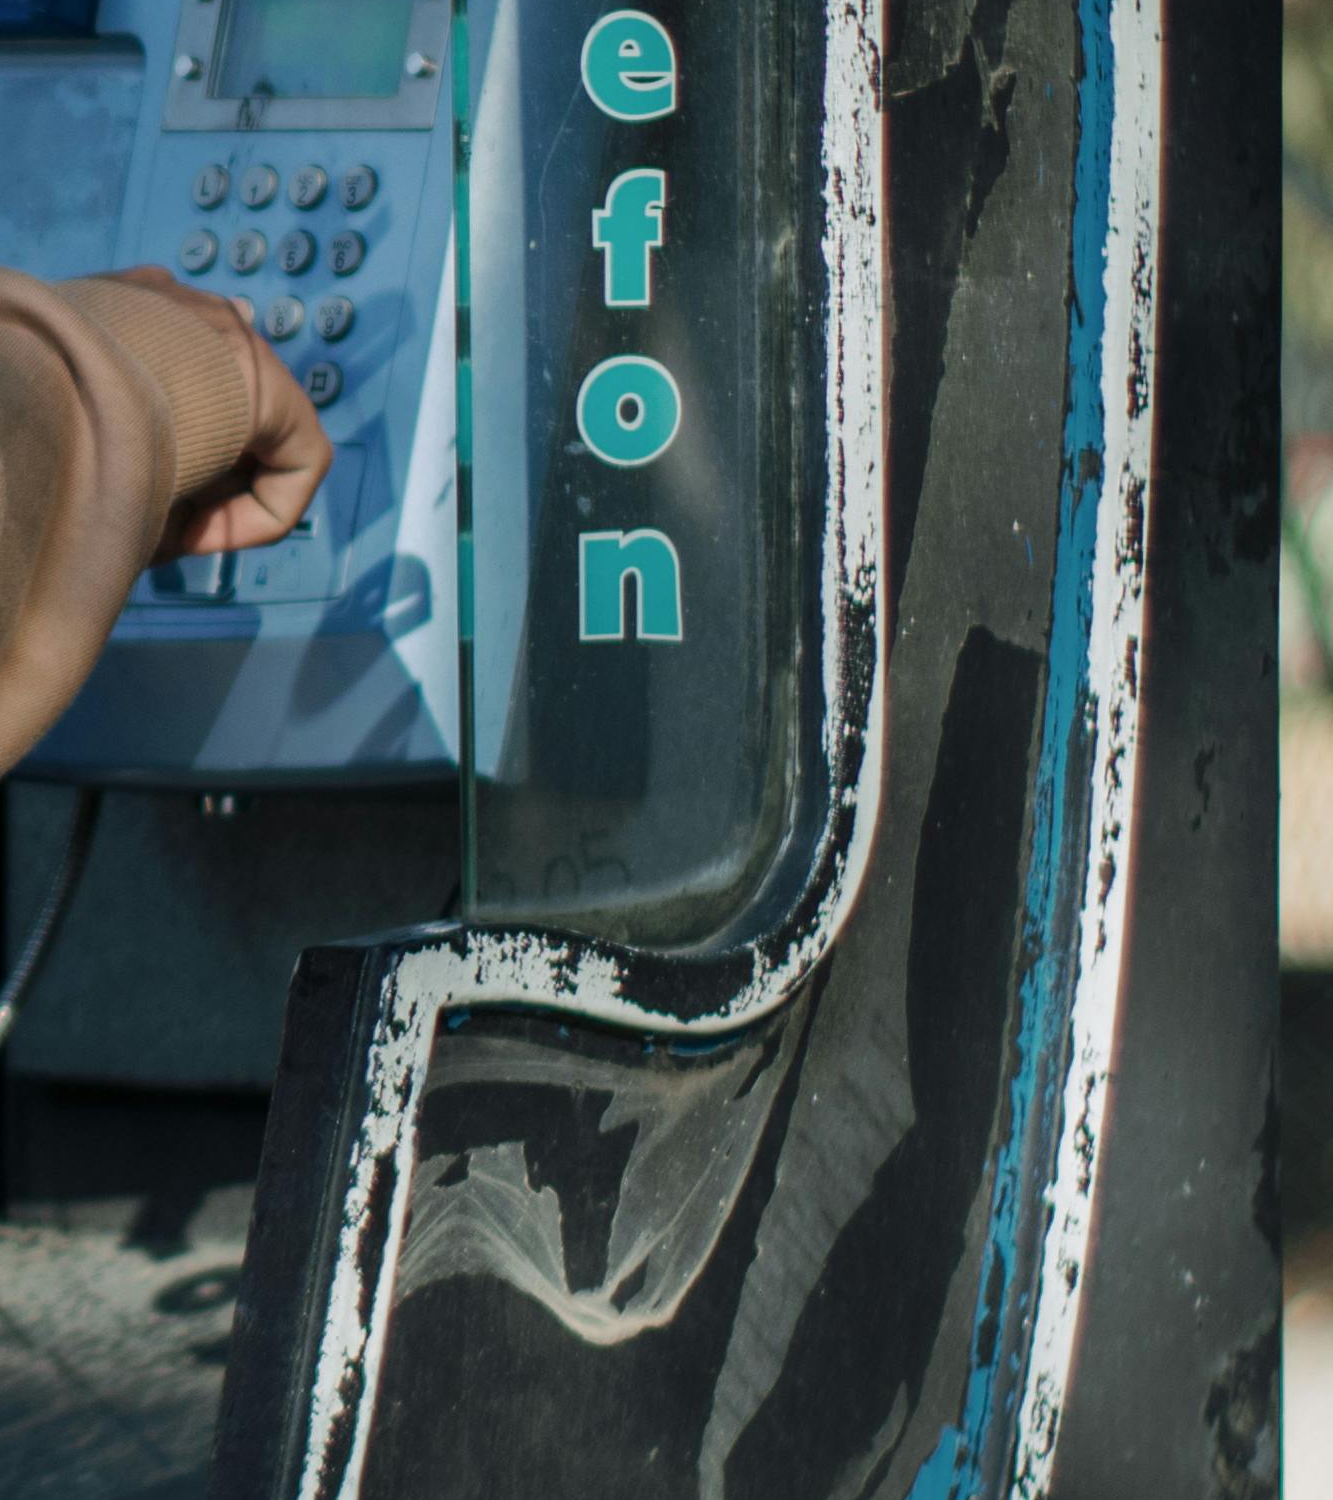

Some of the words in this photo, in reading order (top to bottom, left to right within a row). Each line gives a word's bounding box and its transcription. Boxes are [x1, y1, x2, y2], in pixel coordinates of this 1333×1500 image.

[249, 184, 259, 203] 1
[296, 186, 309, 204] 2
[346, 186, 357, 205] 3
[236, 250, 247, 268] 4
[285, 250, 296, 269] 5
[334, 250, 346, 270] 6
[274, 316, 285, 334] 8
[324, 317, 336, 335] 9
